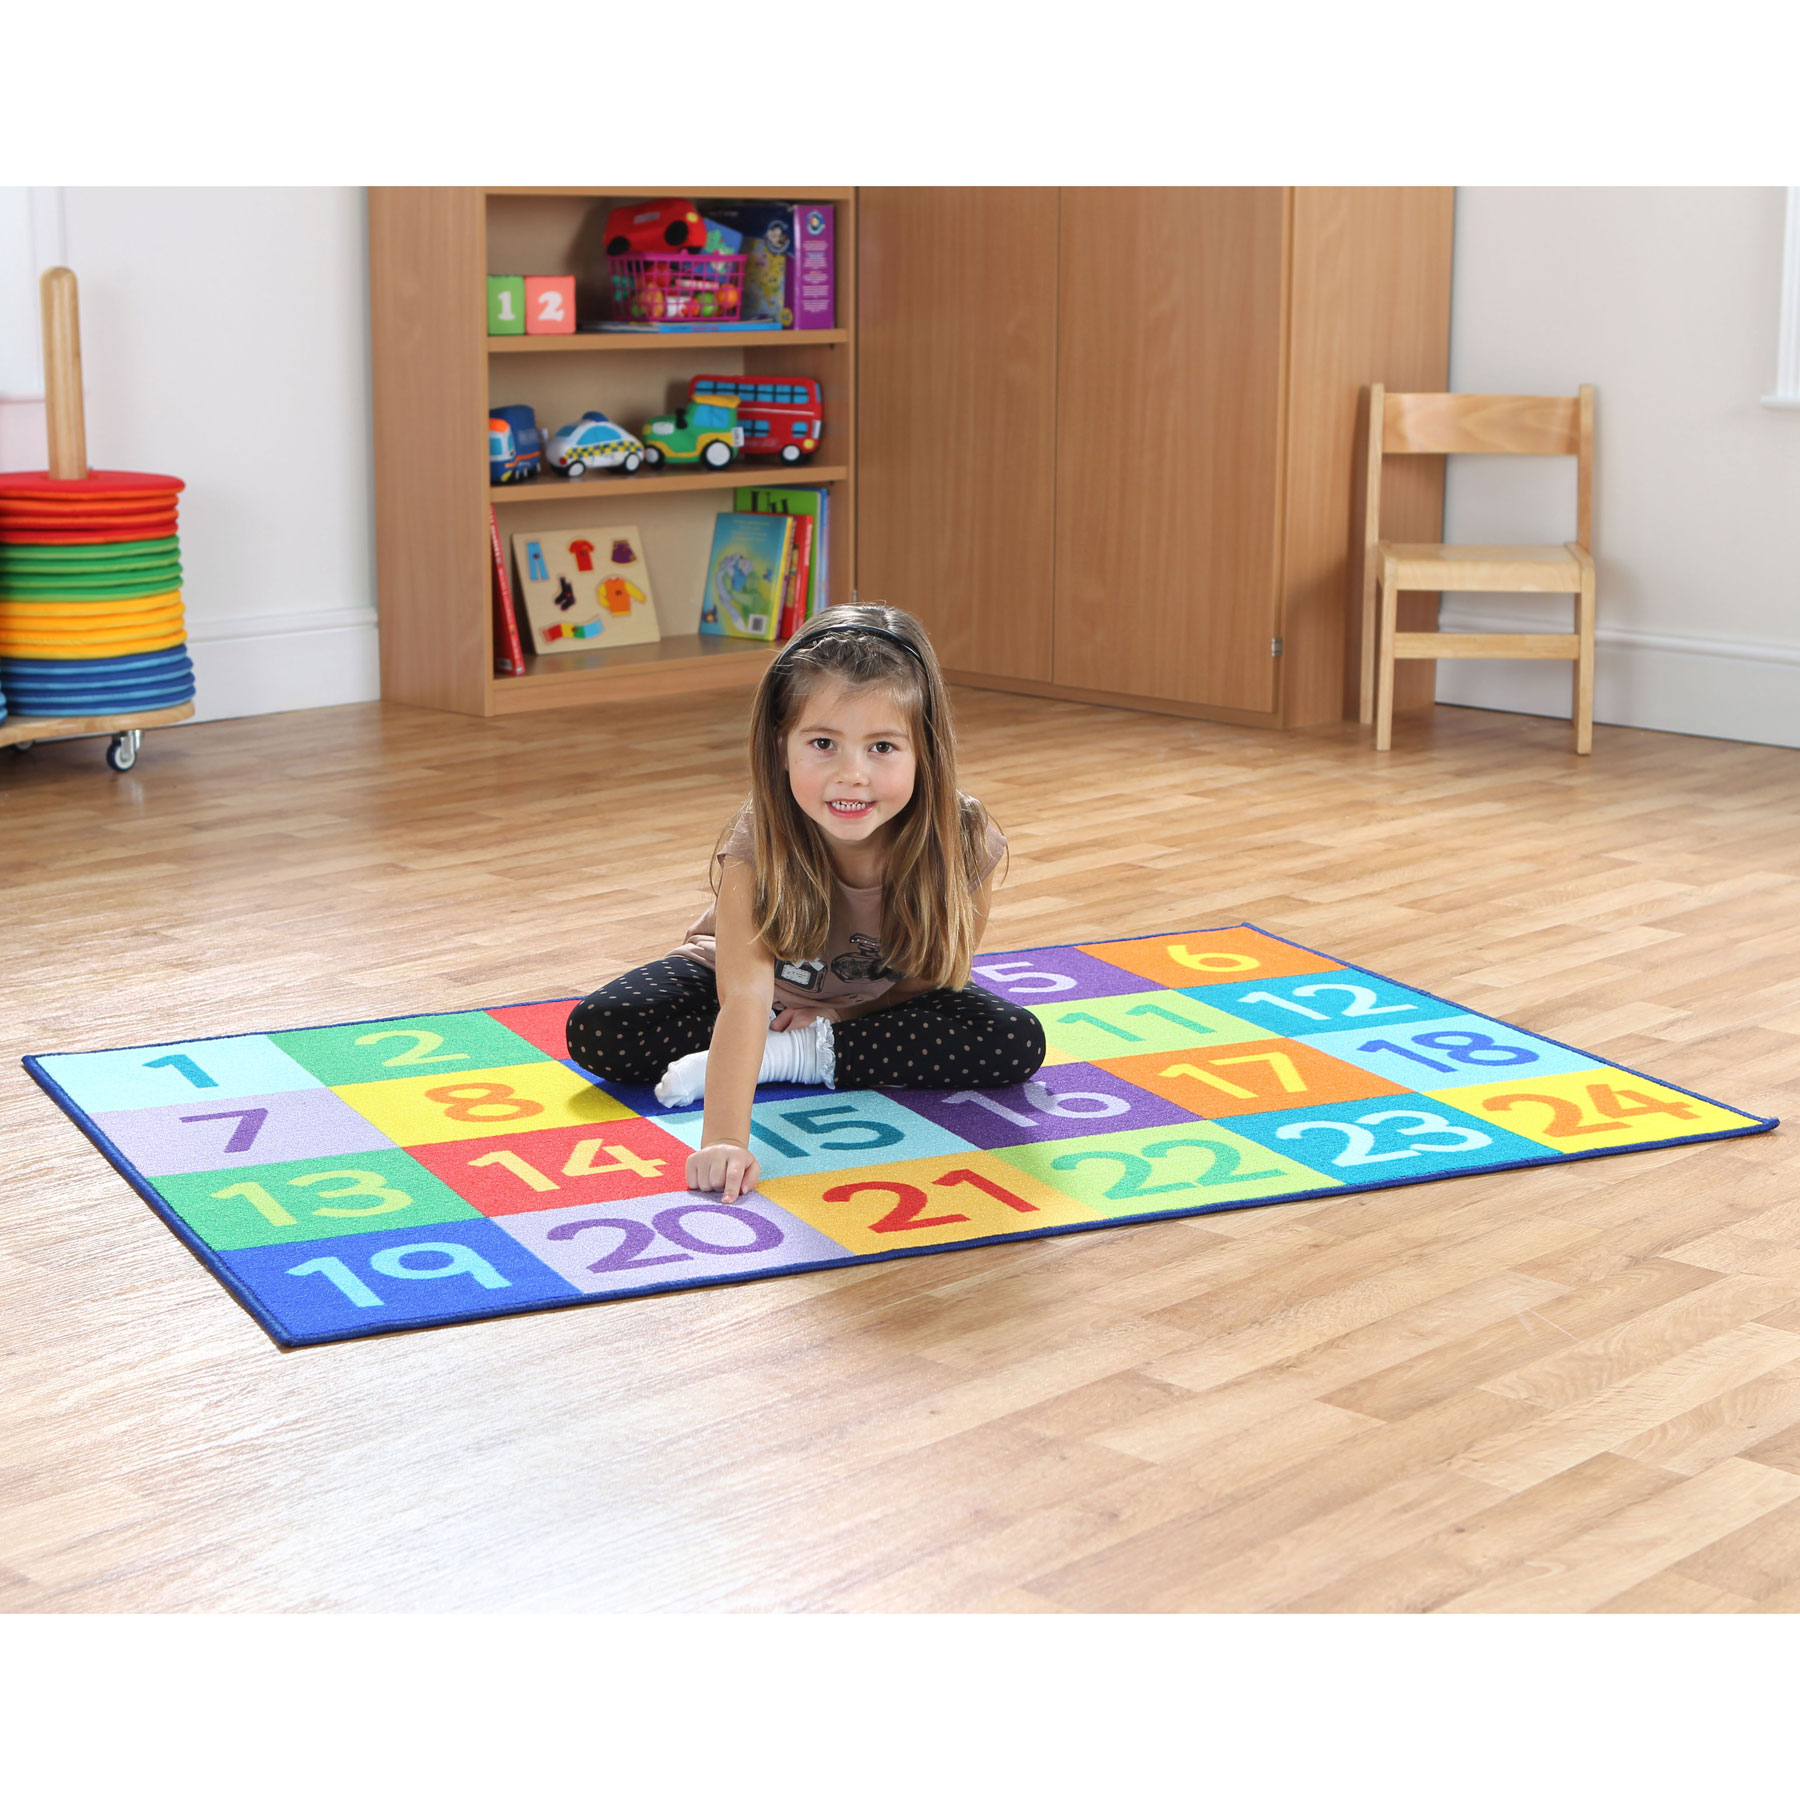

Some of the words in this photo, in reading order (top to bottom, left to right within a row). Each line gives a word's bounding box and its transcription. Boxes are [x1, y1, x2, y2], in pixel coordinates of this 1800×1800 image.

[497, 291, 516, 321] 1
[537, 291, 565, 321] 2
[971, 961, 1078, 993] 5
[1166, 944, 1260, 973] 6
[1057, 1004, 1218, 1043] 11
[1236, 983, 1418, 1021] 12
[143, 1053, 219, 1089] 1
[354, 1030, 470, 1067] 2
[1356, 1030, 1540, 1074] 18
[1158, 1051, 1313, 1099] 17
[424, 1082, 544, 1123] 8
[941, 1081, 1132, 1128] 16
[1481, 1080, 1702, 1138] 24
[179, 1108, 269, 1153] 7
[749, 1105, 905, 1159] 15
[1276, 1109, 1494, 1167] 23
[467, 1139, 668, 1193] 14
[1050, 1138, 1288, 1200] 22
[210, 1169, 414, 1227] 13
[822, 1168, 1041, 1234] 21
[546, 1203, 785, 1274] 20
[285, 1241, 513, 1308] 19
